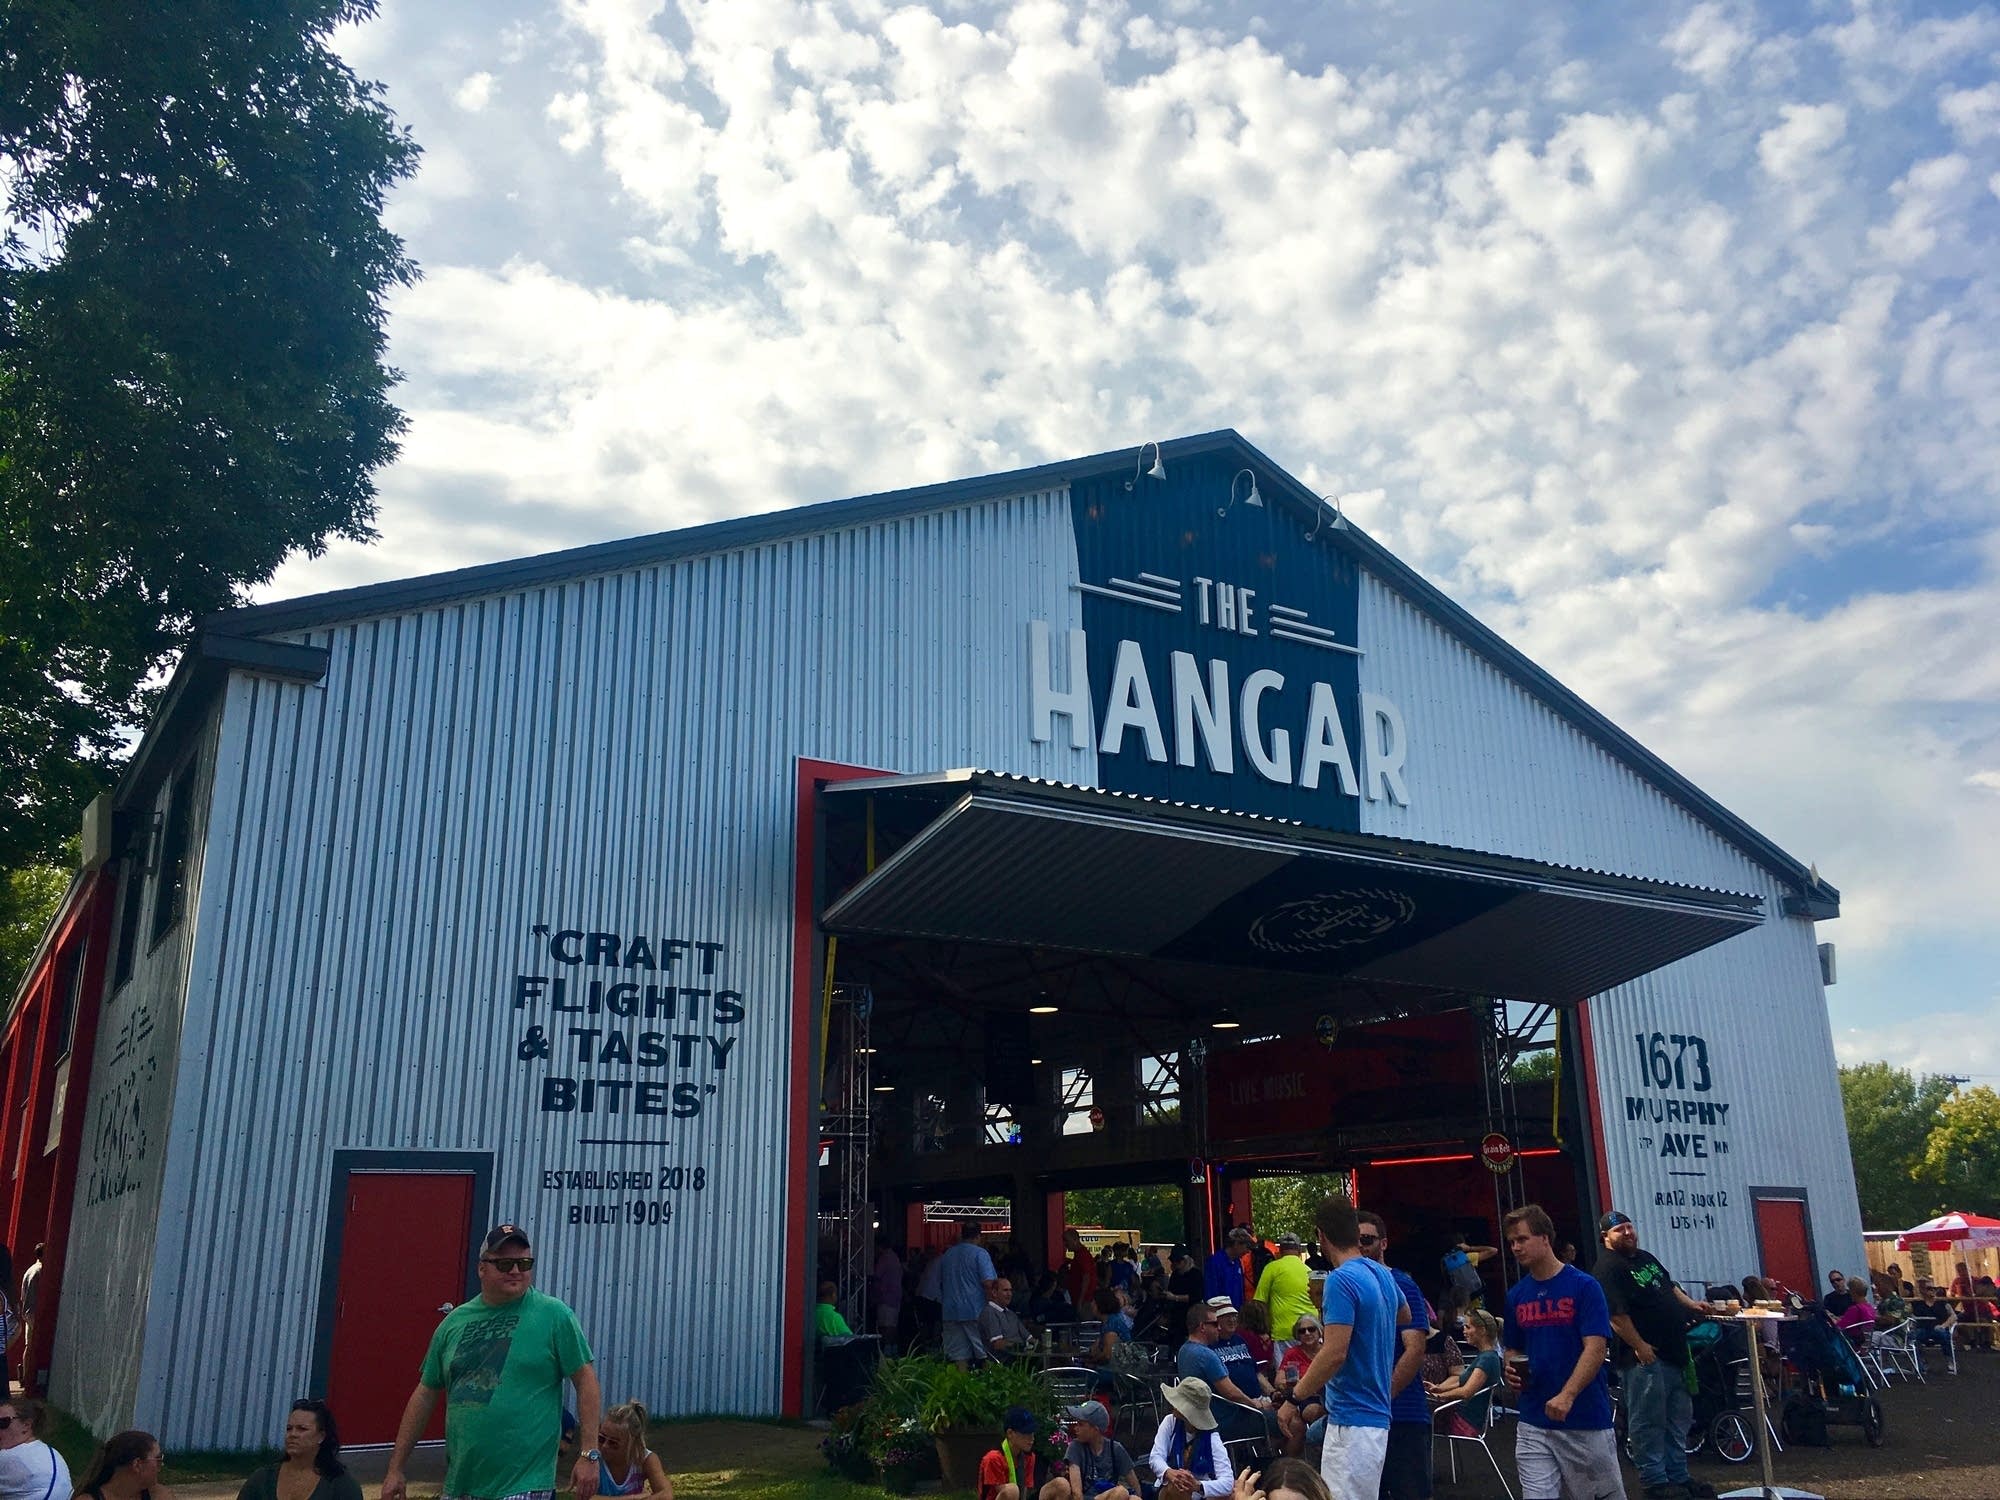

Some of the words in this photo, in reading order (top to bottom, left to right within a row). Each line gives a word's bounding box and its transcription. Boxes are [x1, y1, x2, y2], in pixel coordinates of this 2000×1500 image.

[1193, 576, 1258, 636] THE
[1030, 622, 1409, 806] HANGAR
[514, 975, 746, 1024] FLIGHTS
[517, 1024, 549, 1061] &
[568, 1027, 737, 1070] TASTY
[1635, 1031, 1712, 1092] 1673
[1625, 1096, 1730, 1126] MURPHY
[1660, 1132, 1708, 1158] AVE
[543, 1170, 653, 1191] ESTABLISHED
[658, 1166, 706, 1191] 2018
[569, 1204, 619, 1225] BUILT
[624, 1200, 672, 1226] 1909
[1517, 1297, 1574, 1322] BILLS
